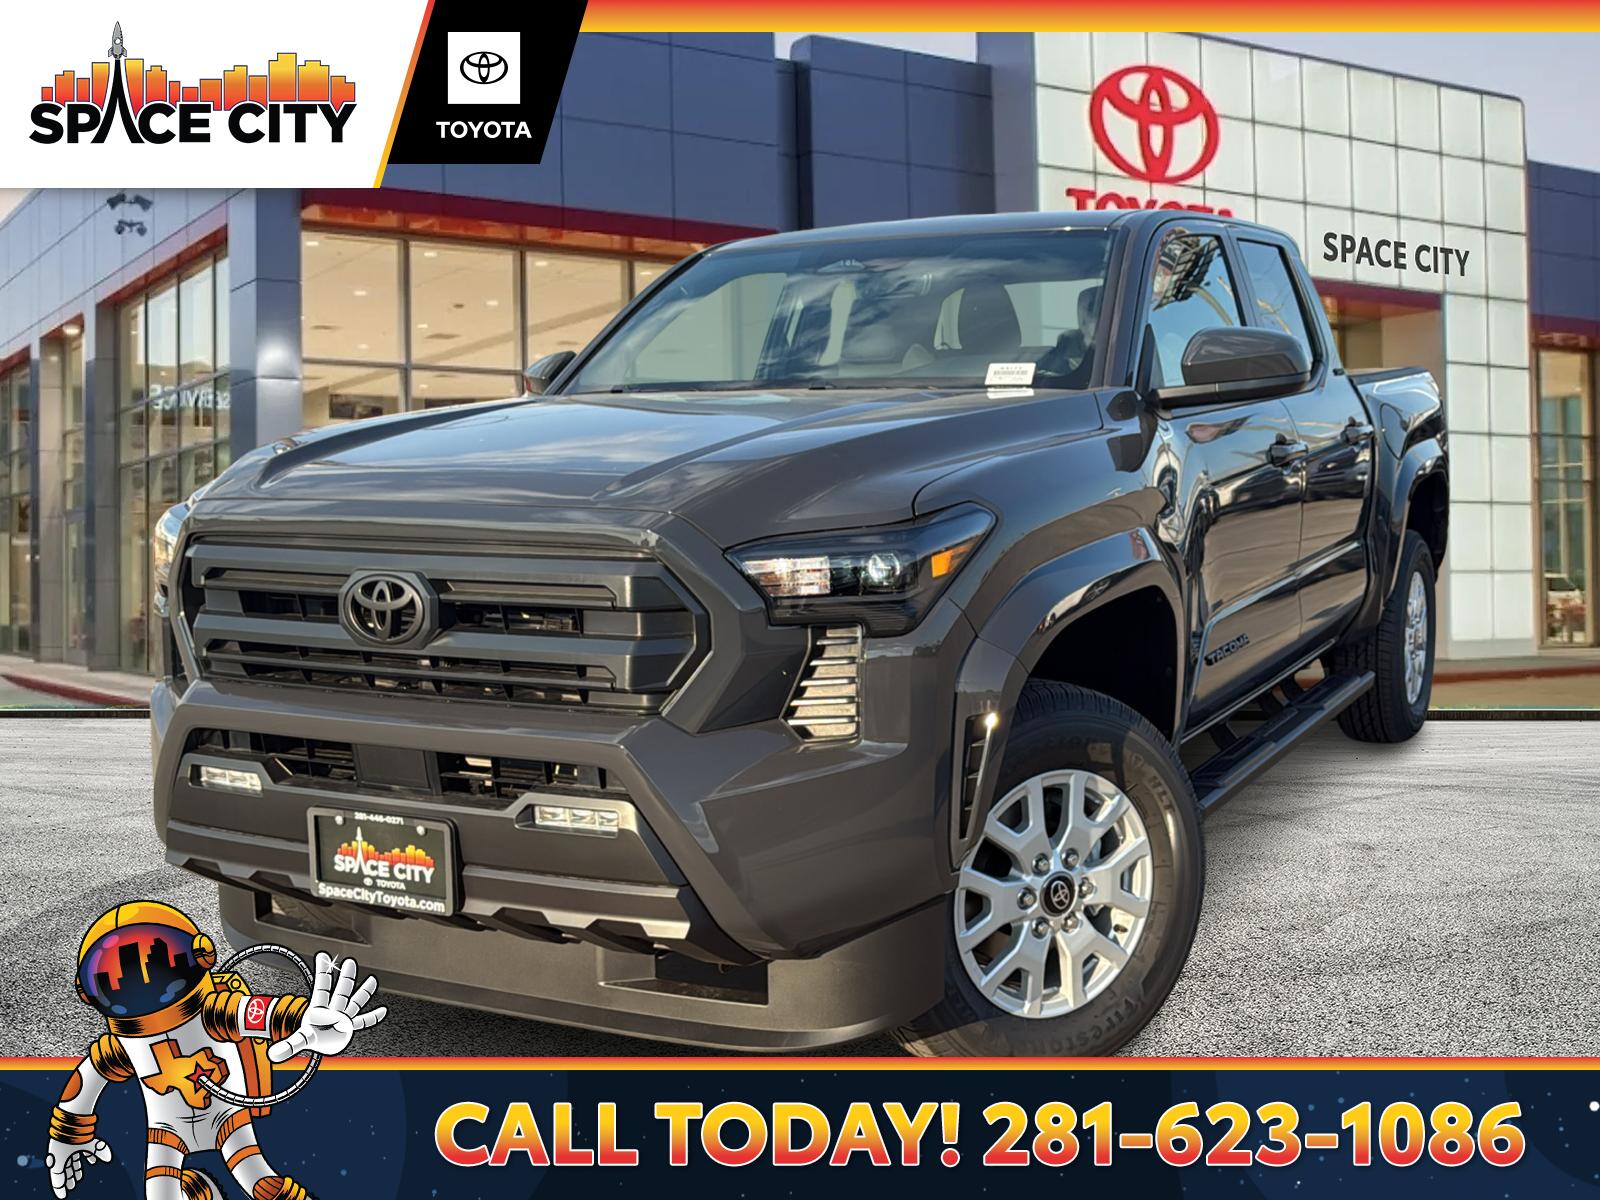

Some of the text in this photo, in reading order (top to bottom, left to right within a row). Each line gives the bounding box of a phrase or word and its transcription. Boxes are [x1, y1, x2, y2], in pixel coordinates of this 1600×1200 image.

[1323, 232, 1470, 276] SPACE CITY
[334, 853, 435, 884] SPACE CITY
[318, 883, 445, 912] SpaceCityToyota.com
[376, 879, 406, 890] TOYOTA
